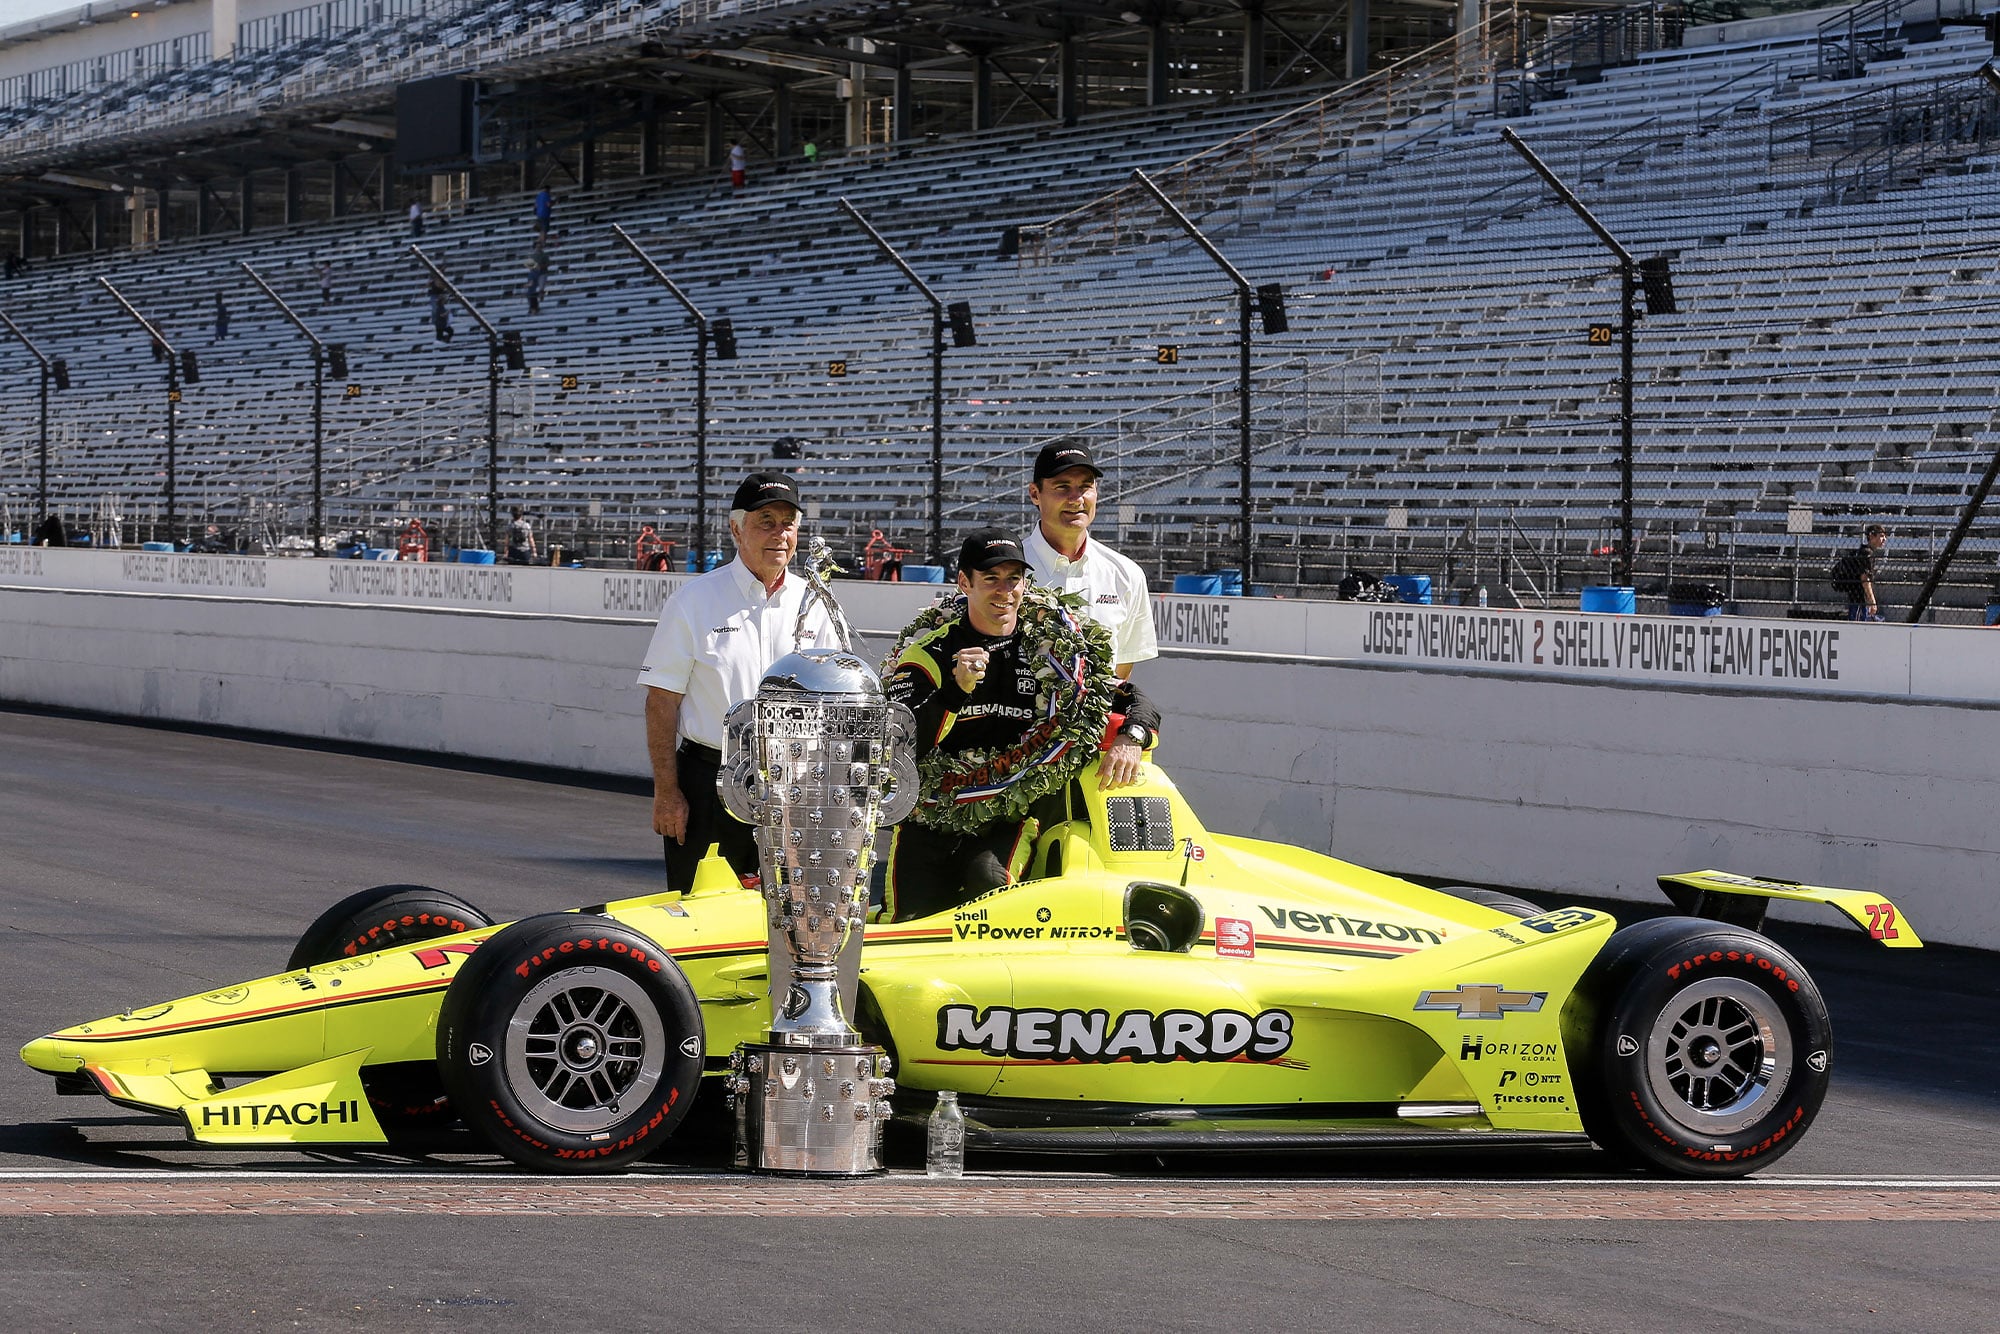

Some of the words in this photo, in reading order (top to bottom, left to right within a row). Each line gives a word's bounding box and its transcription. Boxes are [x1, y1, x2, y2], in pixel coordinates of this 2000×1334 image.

[1590, 327, 1610, 343] 20
[1158, 348, 1177, 362] 21
[829, 362, 846, 375] 22
[347, 385, 360, 396] 24
[561, 376, 577, 388] 23
[443, 568, 512, 602] MANUFACTURING
[603, 578, 642, 610] CHARLIE
[643, 579, 683, 612] KIMB
[1151, 600, 1173, 641] AM
[1175, 602, 1230, 645] STANGE
[1362, 610, 1414, 655] JOSEF
[1417, 613, 1524, 663] NEWGARDEN
[1533, 619, 1545, 664] 2
[1553, 620, 1609, 668] SHELL
[1613, 622, 1626, 669] V
[1629, 623, 1695, 673] POWER
[1700, 626, 1753, 676] TEAM
[1759, 628, 1840, 680] PENSKE
[888, 681, 914, 693] HITACHI
[1018, 680, 1034, 693] PPG
[958, 703, 1033, 719] MENARDS
[941, 767, 989, 794] Borg
[344, 912, 475, 957] Fireston
[955, 923, 1044, 940] V-Power
[1258, 905, 1447, 945] verizon
[1864, 903, 1899, 940] 22
[515, 937, 663, 978] Firestone
[1218, 946, 1252, 957] Speedway
[1667, 949, 1800, 993] Firestone
[936, 1004, 1294, 1063] MENARDS
[1460, 1035, 1557, 1061] HORIZON
[1541, 1075, 1562, 1083] NTT
[1492, 1093, 1566, 1104] Firestone
[202, 1100, 360, 1126] HITACHI
[554, 1087, 681, 1160] FIREHAWK
[1683, 1105, 1805, 1161] FIREHAWK
